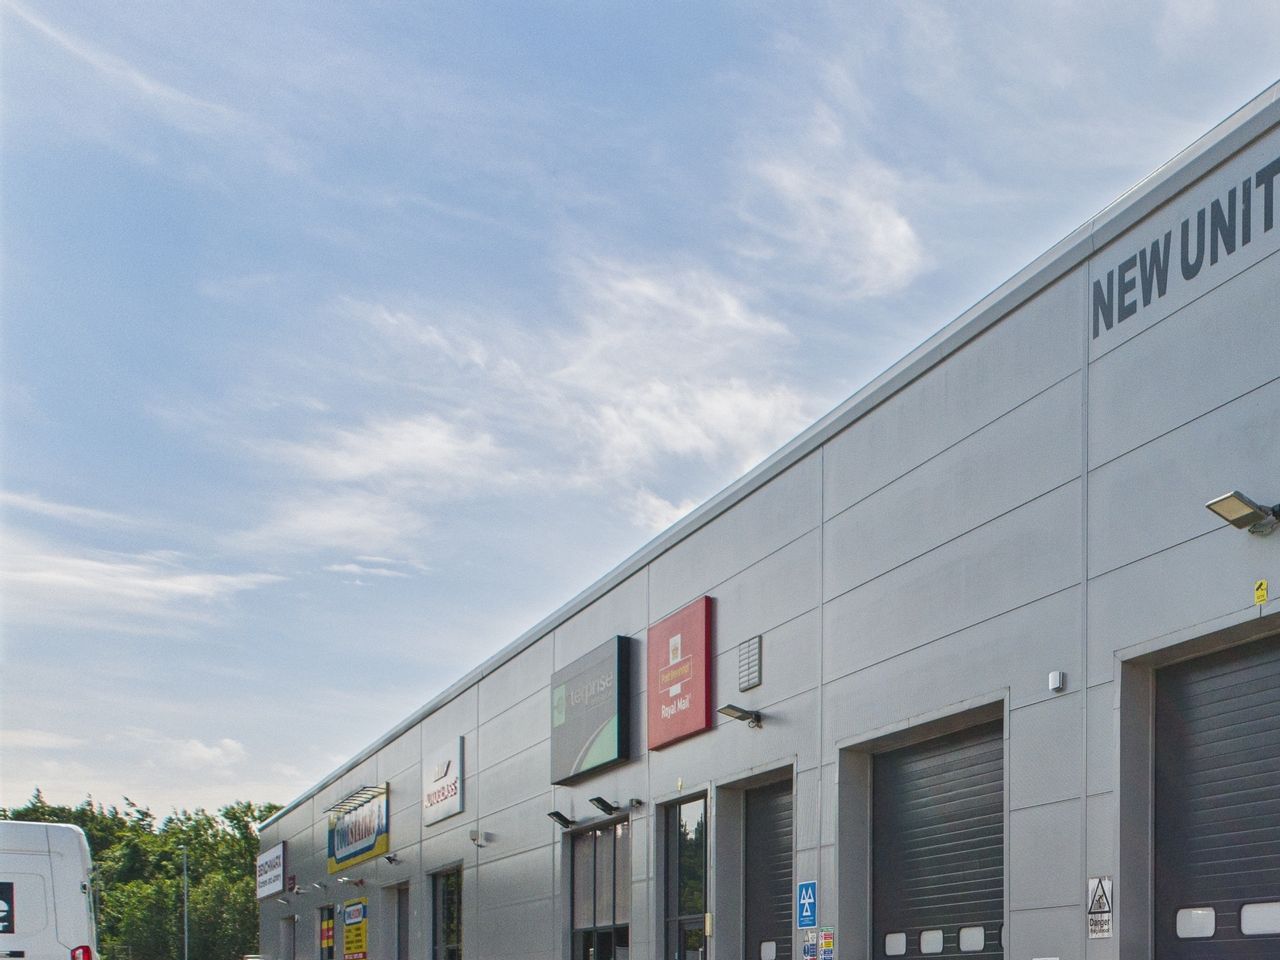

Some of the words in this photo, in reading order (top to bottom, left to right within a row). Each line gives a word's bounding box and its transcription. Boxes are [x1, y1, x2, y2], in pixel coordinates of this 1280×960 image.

[1092, 230, 1171, 339] NEW
[661, 700, 676, 719] Royal
[676, 694, 690, 711] Mail
[1089, 918, 1110, 928] Danger
